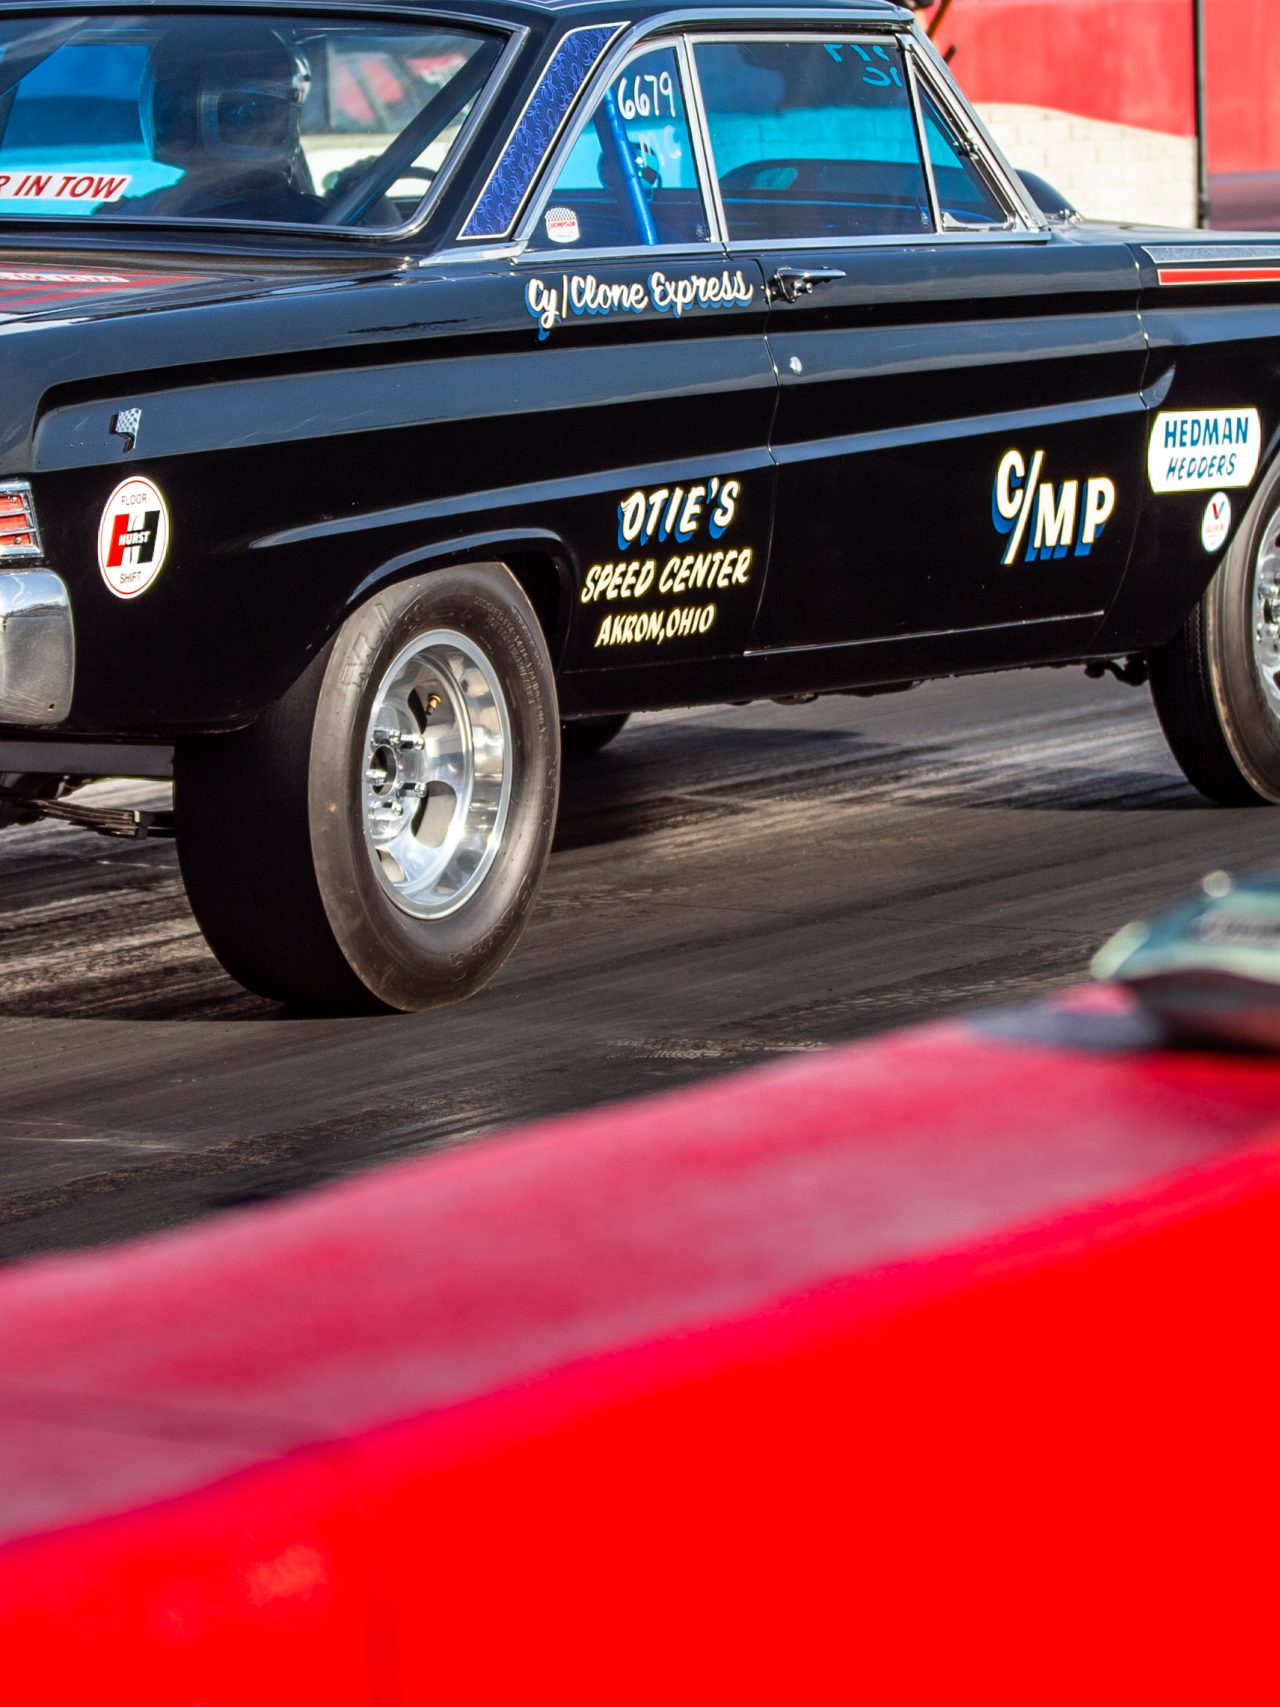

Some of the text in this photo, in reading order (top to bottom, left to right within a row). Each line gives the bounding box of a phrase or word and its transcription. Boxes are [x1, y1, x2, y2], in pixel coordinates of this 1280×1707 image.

[617, 71, 676, 120] 6679
[13, 175, 53, 197] IN
[55, 175, 127, 198] TOW
[651, 270, 754, 317] Express
[1164, 416, 1249, 448] HEDMAN
[1166, 452, 1237, 480] HEDDERS
[121, 493, 147, 506] FLOOR
[619, 477, 740, 544] OTIE'S
[995, 449, 1116, 565] C/MP
[118, 530, 152, 547] HURST
[119, 570, 142, 584] SHIFT
[580, 548, 752, 604] SPEED CENTER
